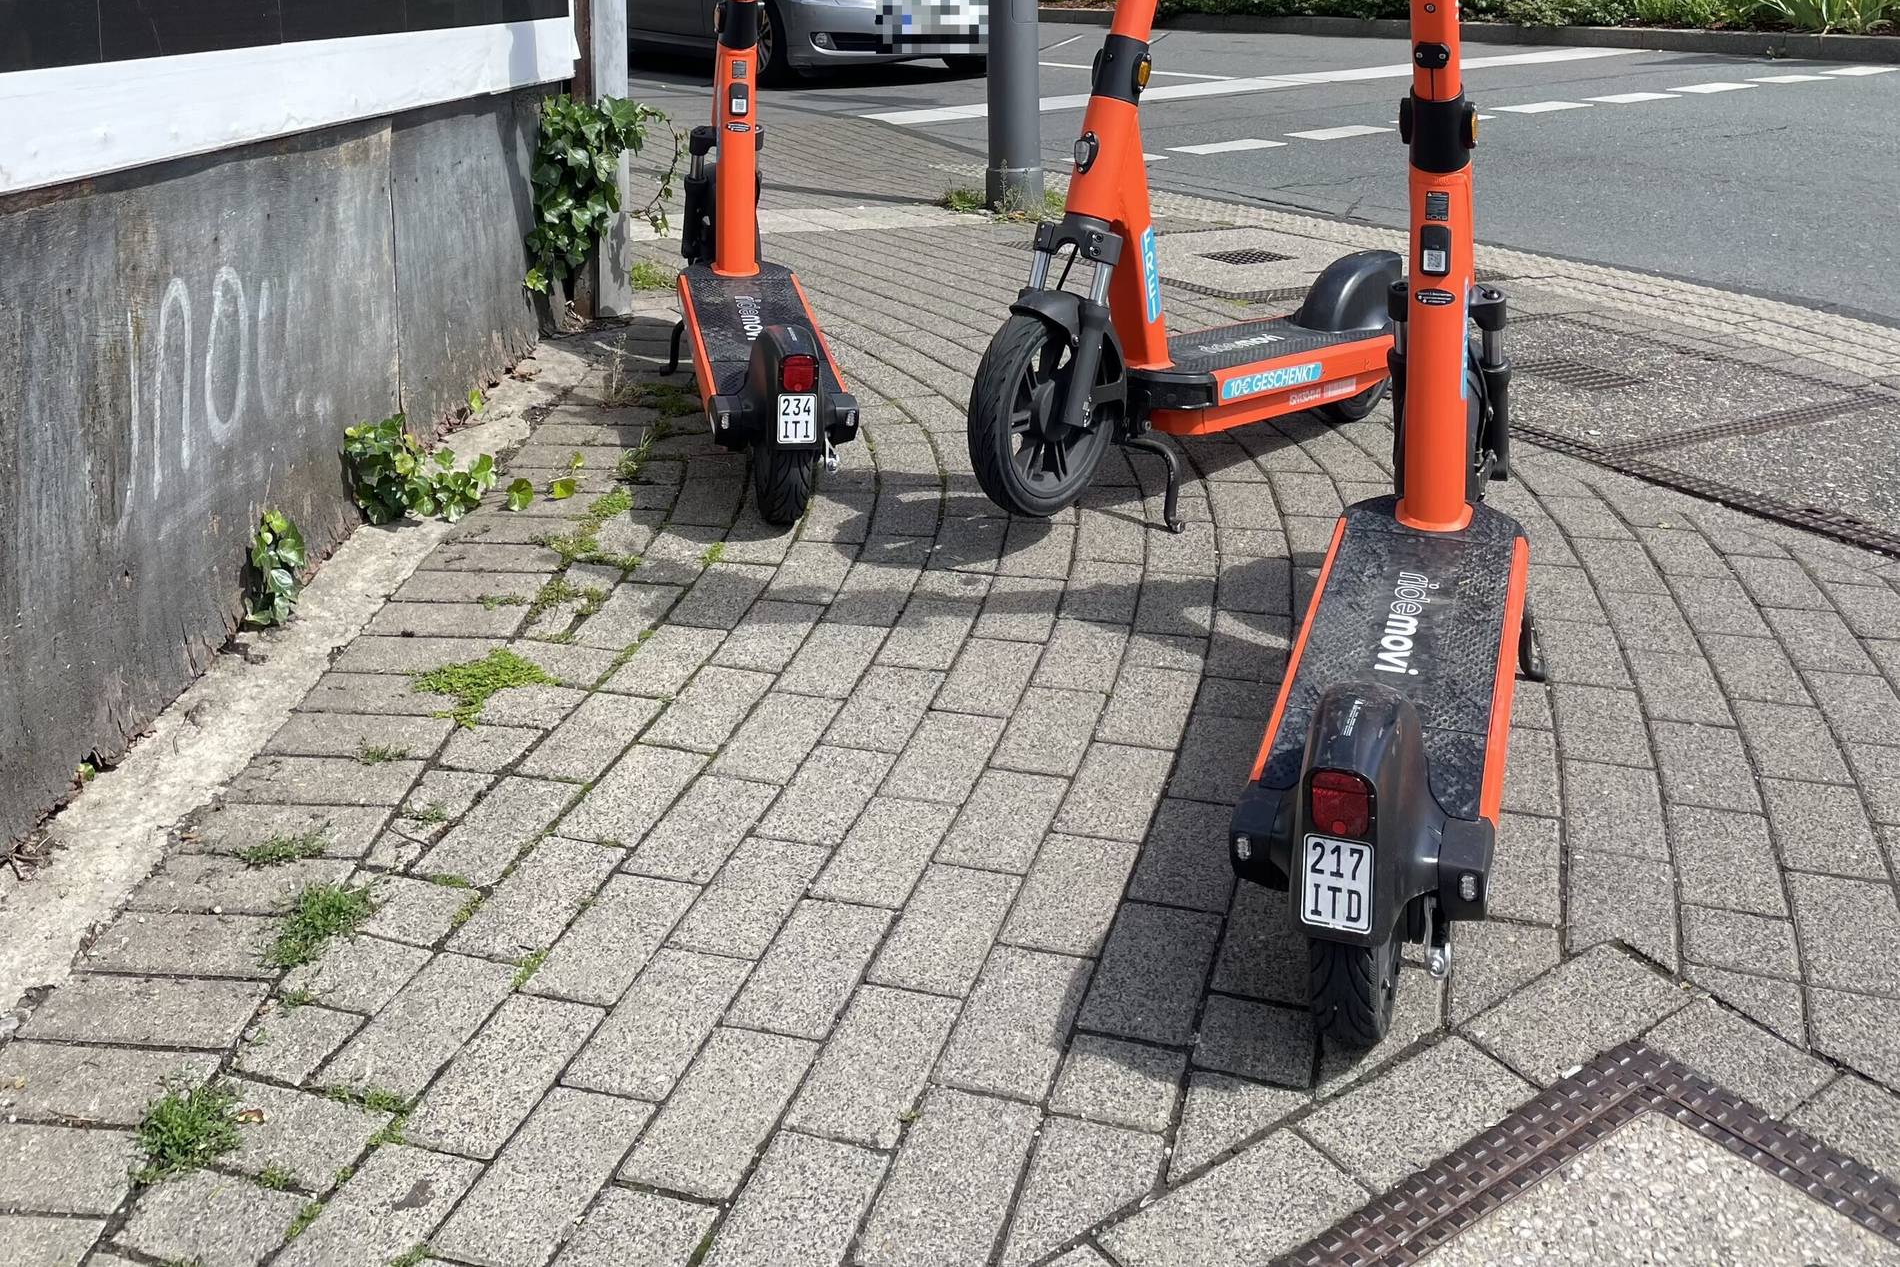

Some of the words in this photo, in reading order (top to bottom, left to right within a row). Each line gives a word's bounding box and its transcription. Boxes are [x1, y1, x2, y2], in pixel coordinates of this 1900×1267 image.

[1143, 227, 1157, 318] FREI
[1229, 379, 1251, 398] 10€
[1252, 364, 1316, 392] GESCHENKT
[782, 398, 812, 416] 234
[783, 421, 811, 438] ITI
[1374, 572, 1440, 676] ridemovi
[1310, 841, 1364, 881] 217
[1310, 883, 1362, 923] ITD
